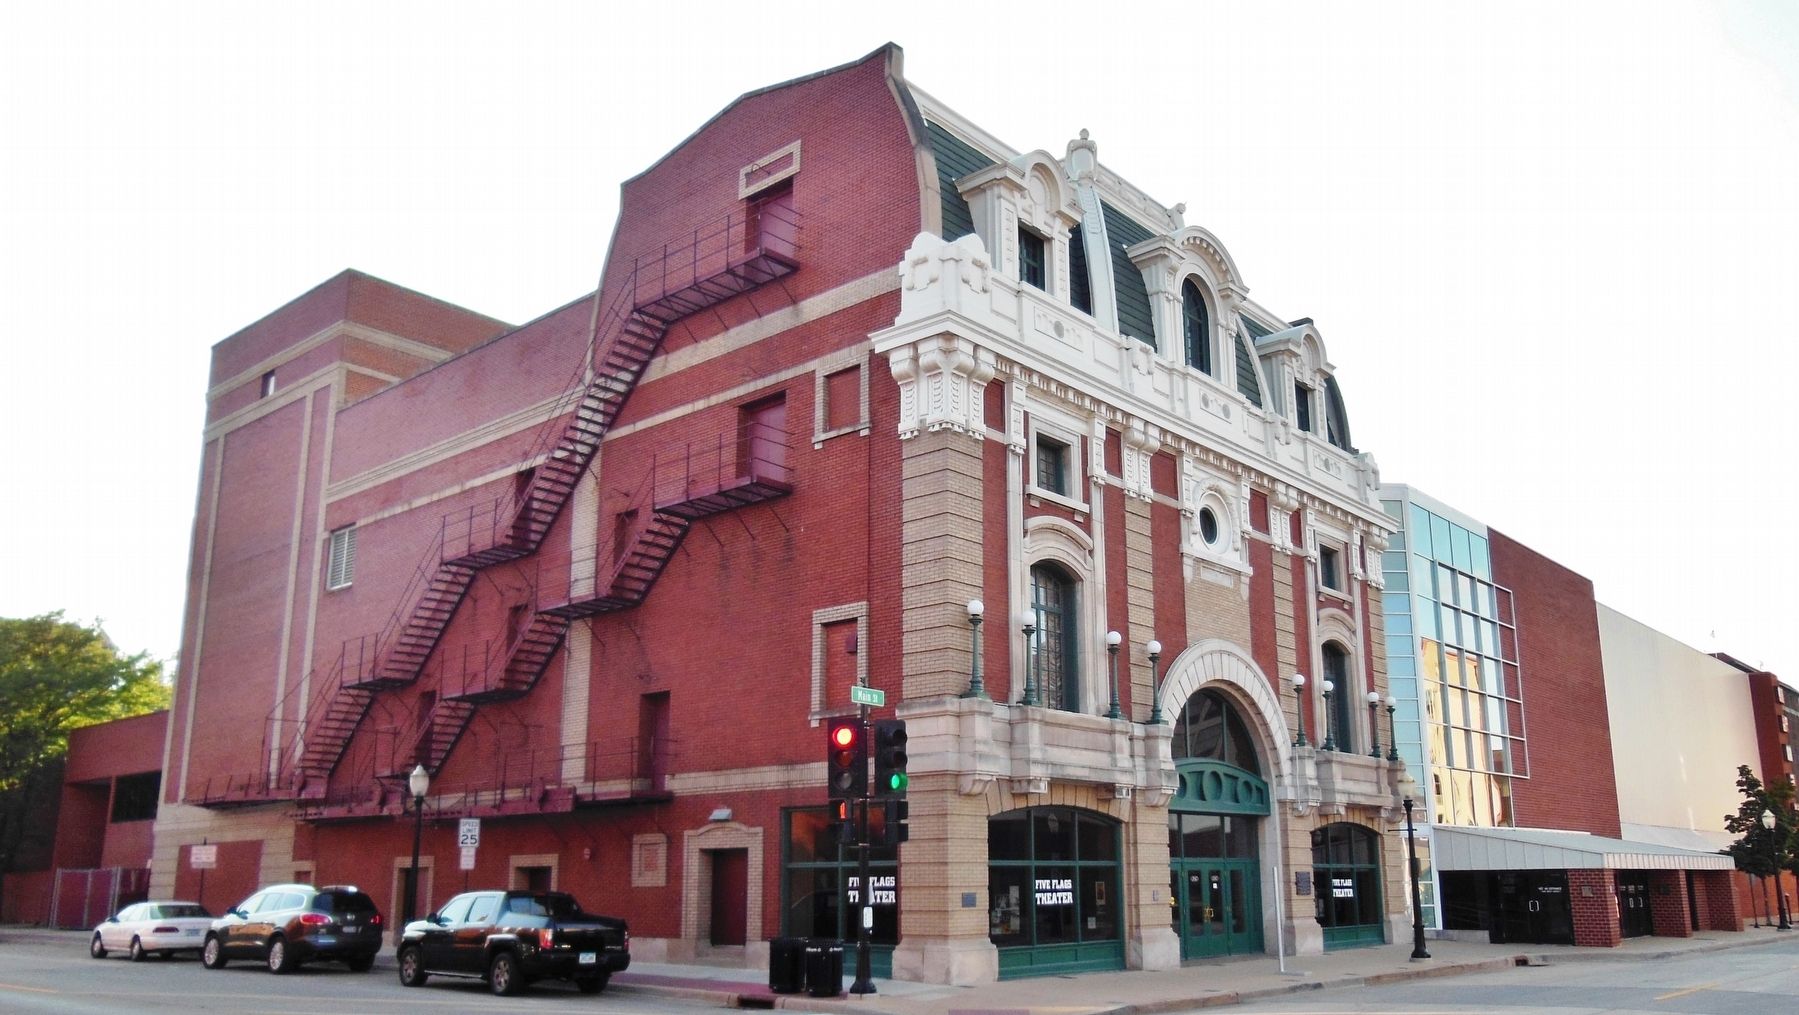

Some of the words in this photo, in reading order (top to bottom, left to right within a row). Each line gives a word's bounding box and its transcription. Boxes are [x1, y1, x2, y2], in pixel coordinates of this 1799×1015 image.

[857, 690, 871, 702] Main
[461, 834, 478, 845] 25
[869, 876, 896, 887] FLAGS
[1035, 879, 1051, 890] FIVE
[1051, 879, 1072, 890] FLAGS
[848, 890, 896, 903] TTER
[1035, 892, 1073, 905] THEATER
